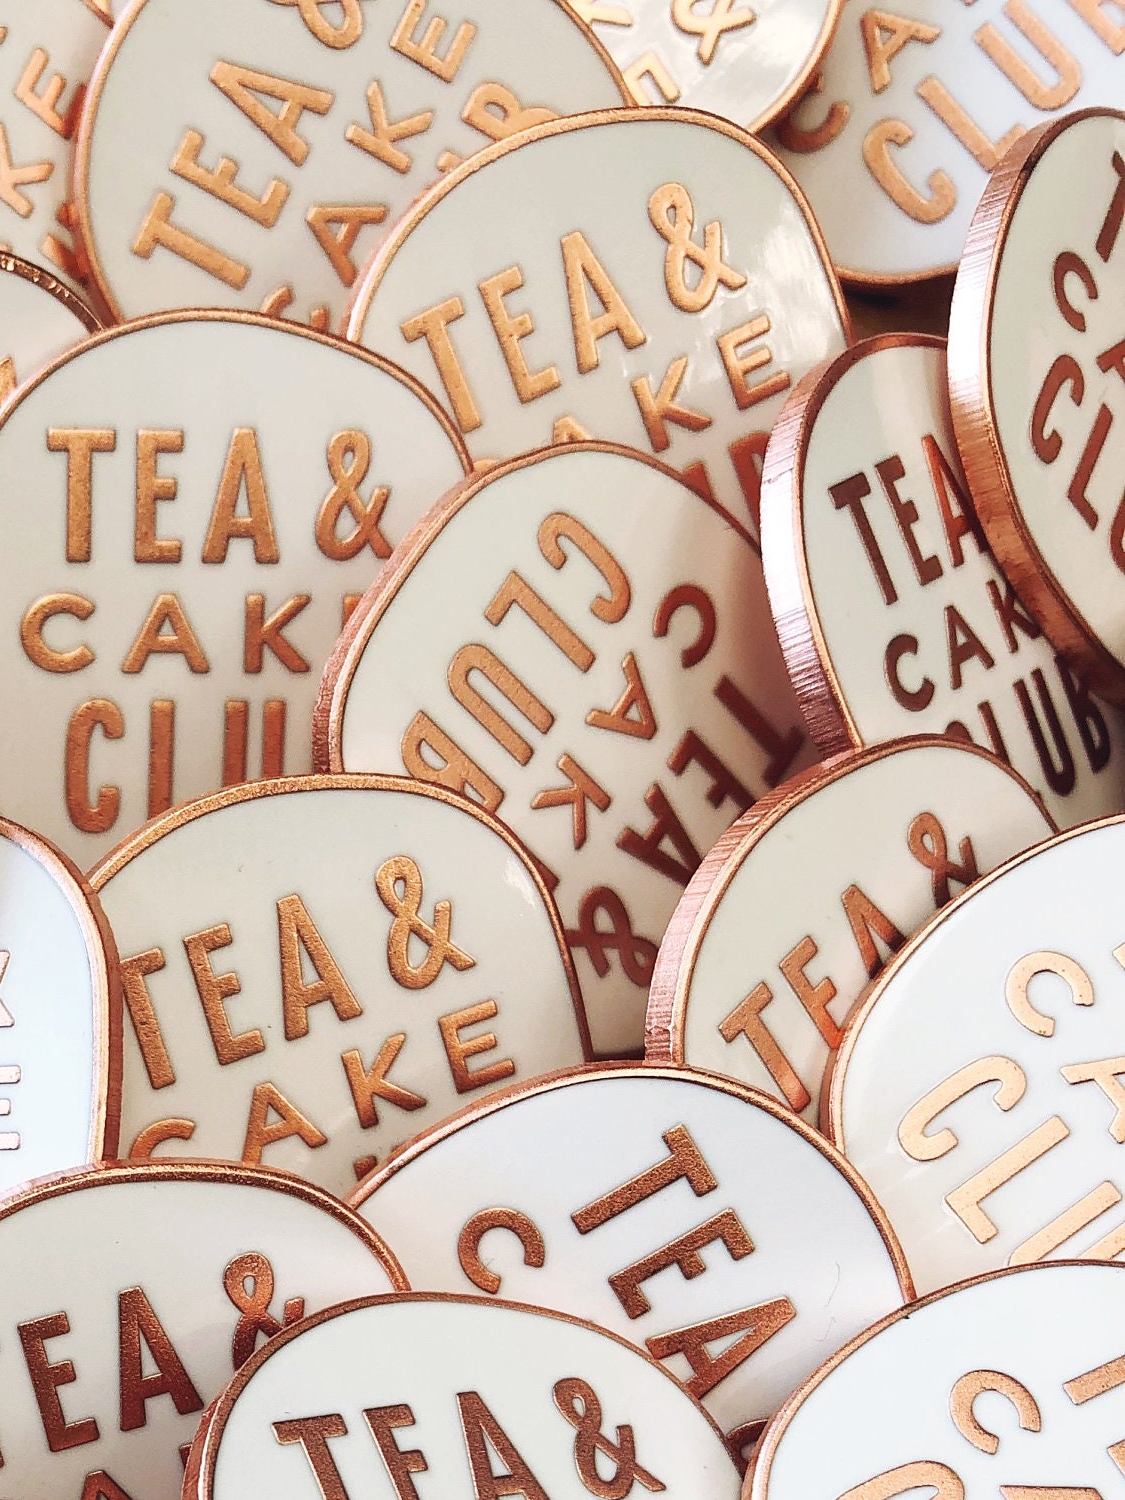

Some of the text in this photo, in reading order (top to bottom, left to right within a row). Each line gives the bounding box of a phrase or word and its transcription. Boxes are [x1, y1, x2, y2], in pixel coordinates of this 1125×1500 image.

[132, 60, 335, 290] TEA
[401, 181, 747, 432] TEA &
[46, 427, 394, 564] TEA &
[827, 433, 987, 605] TEA
[20, 592, 350, 673] CAK
[121, 855, 474, 1089] TEA &
[572, 1124, 796, 1400] TEA
[552, 1377, 667, 1500] &
